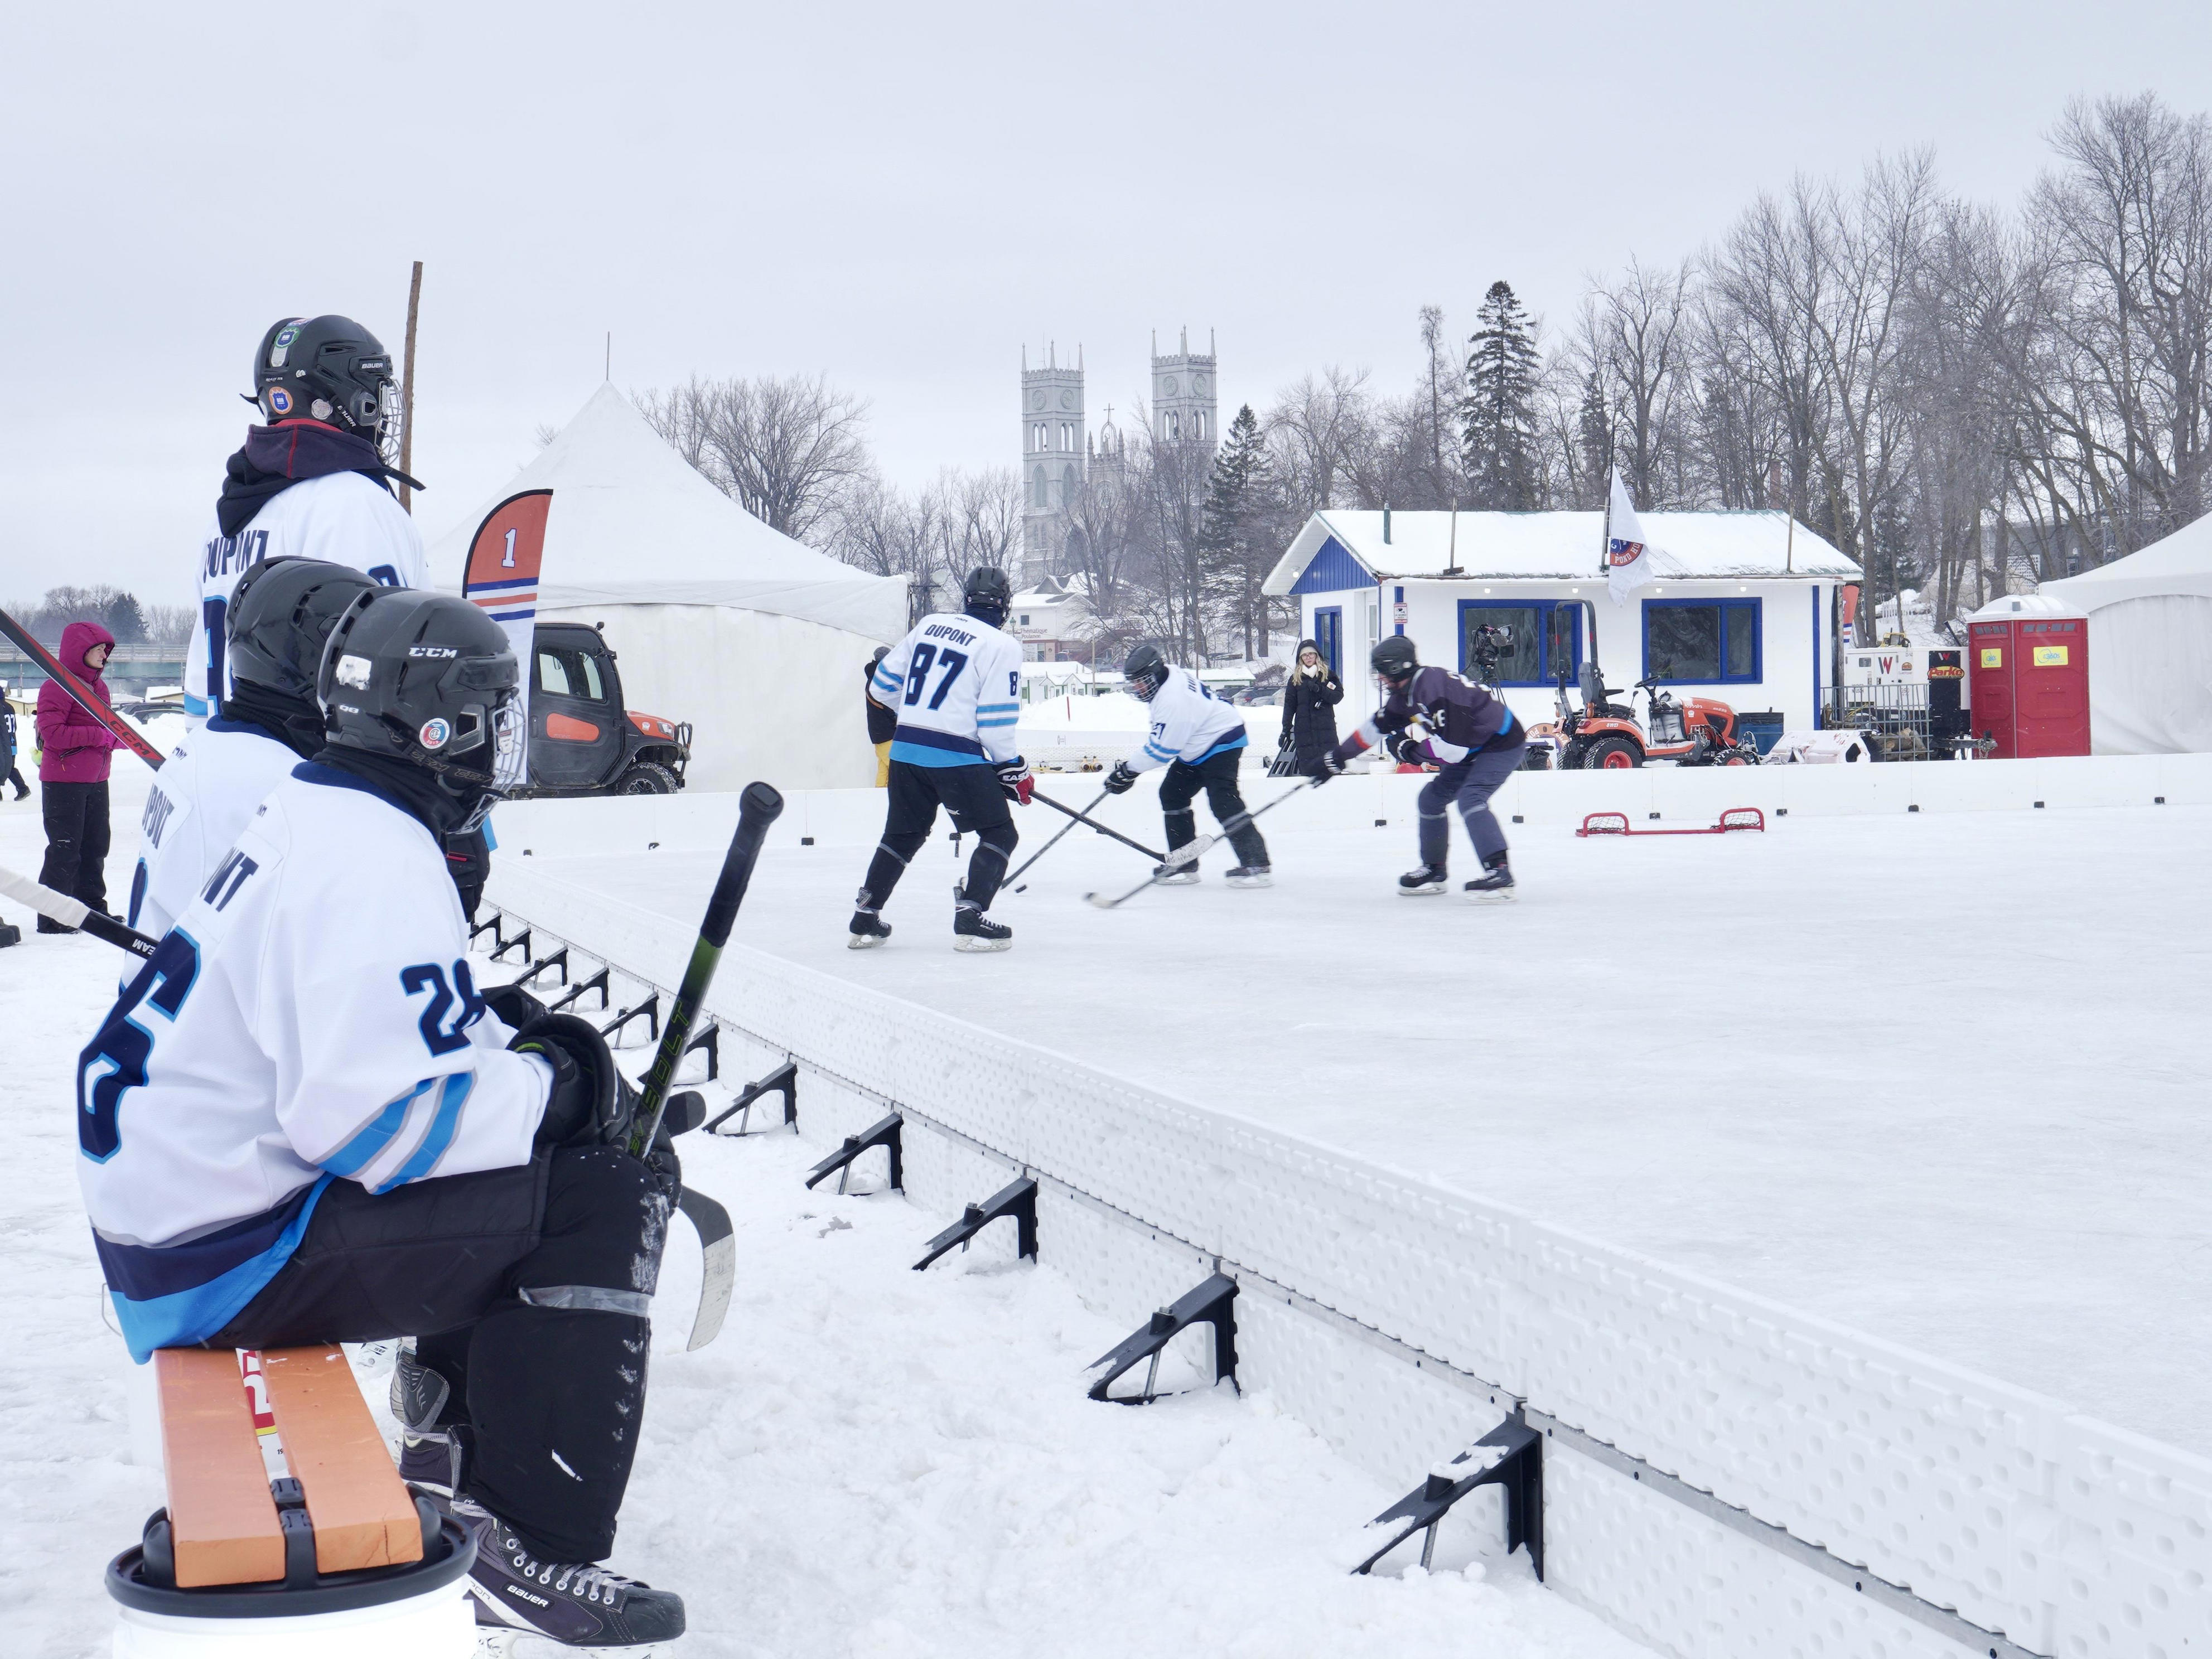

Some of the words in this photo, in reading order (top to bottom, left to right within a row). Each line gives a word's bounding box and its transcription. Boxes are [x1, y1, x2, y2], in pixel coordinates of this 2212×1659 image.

[501, 528, 517, 568] 1
[1615, 553, 1632, 564] POND
[924, 623, 977, 647] DUPONT
[408, 646, 457, 659] CCM
[904, 641, 969, 712] 87
[1009, 671, 1021, 697] 8
[132, 939, 157, 956] EAM
[506, 1584, 549, 1608] BAUER
